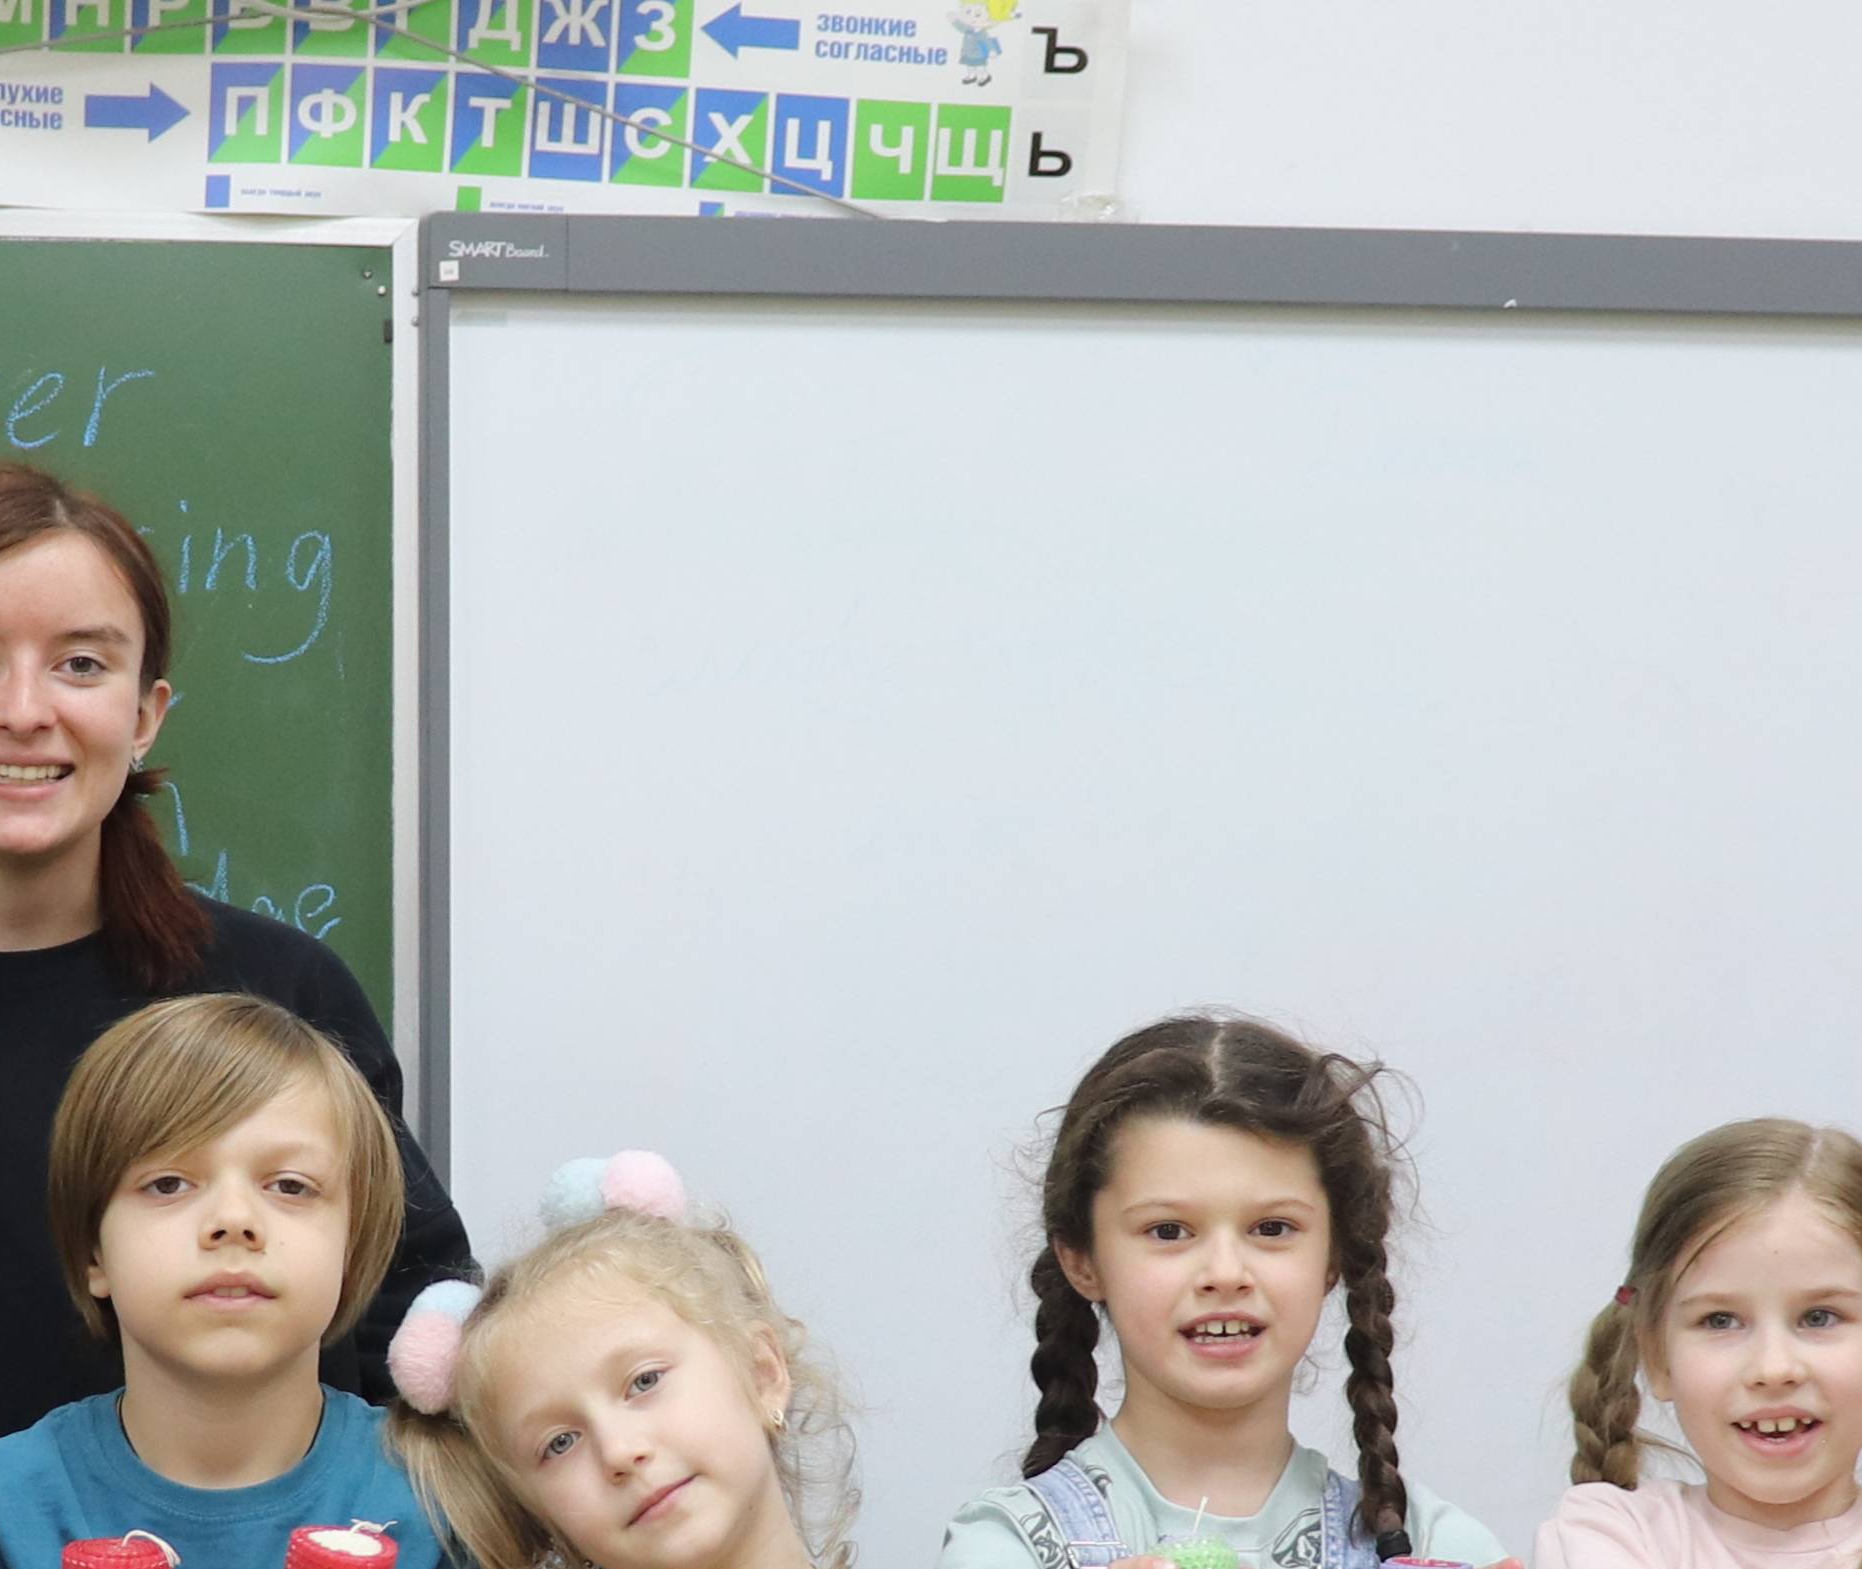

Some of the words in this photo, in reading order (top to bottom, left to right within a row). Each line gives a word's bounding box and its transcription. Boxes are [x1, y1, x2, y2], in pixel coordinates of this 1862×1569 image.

[542, 0, 608, 48] Ж
[814, 39, 948, 67] согласные
[224, 85, 270, 137] П
[297, 87, 358, 139] Ф
[388, 91, 431, 145] К
[535, 101, 603, 155] Ш
[784, 117, 833, 181] Ц
[869, 123, 915, 174] Ч
[448, 239, 506, 258] SMART
